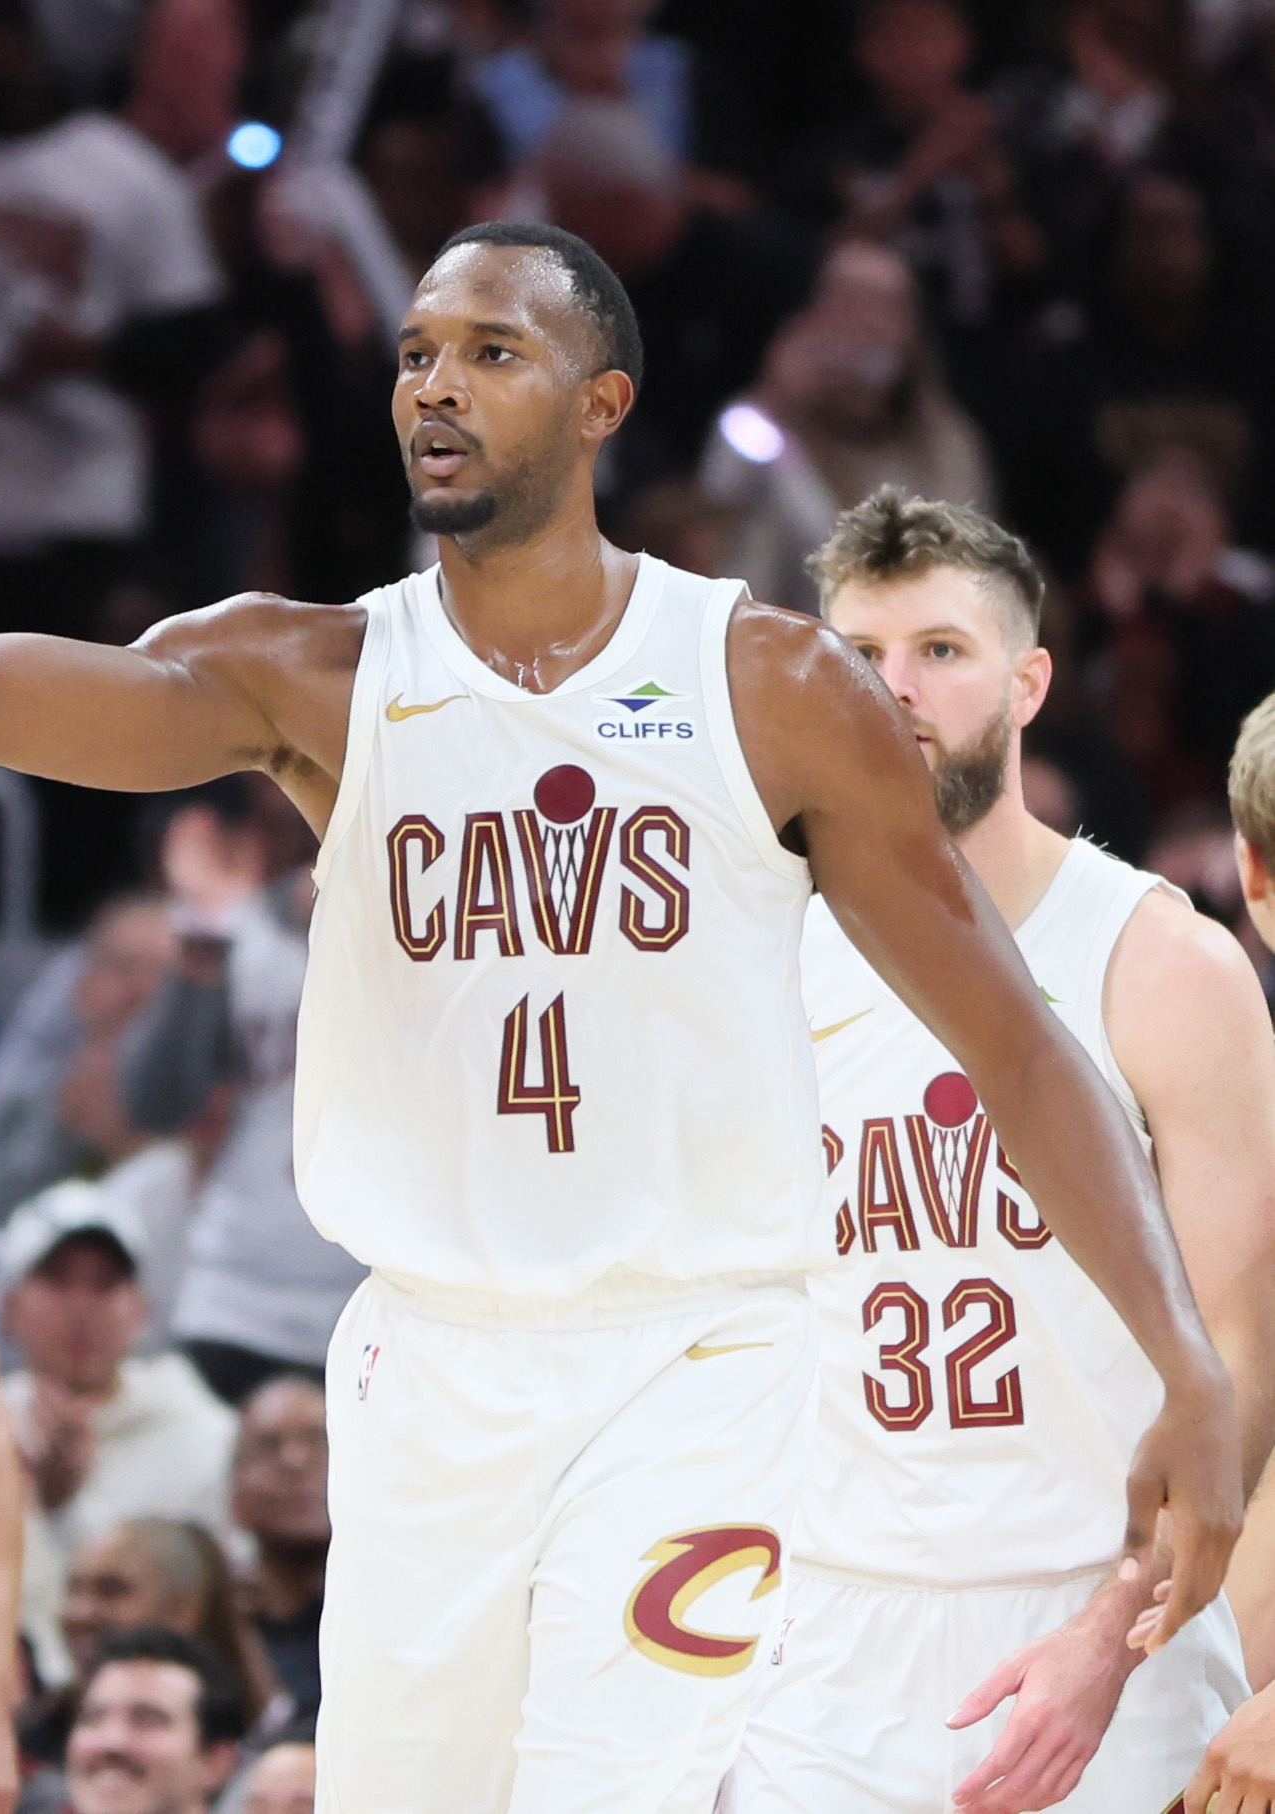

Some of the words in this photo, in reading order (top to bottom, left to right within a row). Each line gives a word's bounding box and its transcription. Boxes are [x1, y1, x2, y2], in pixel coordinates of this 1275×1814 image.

[597, 722, 694, 739] CLIFFS
[386, 805, 691, 962] CAVS
[496, 990, 581, 1153] 4
[861, 1278, 1024, 1432] 32
